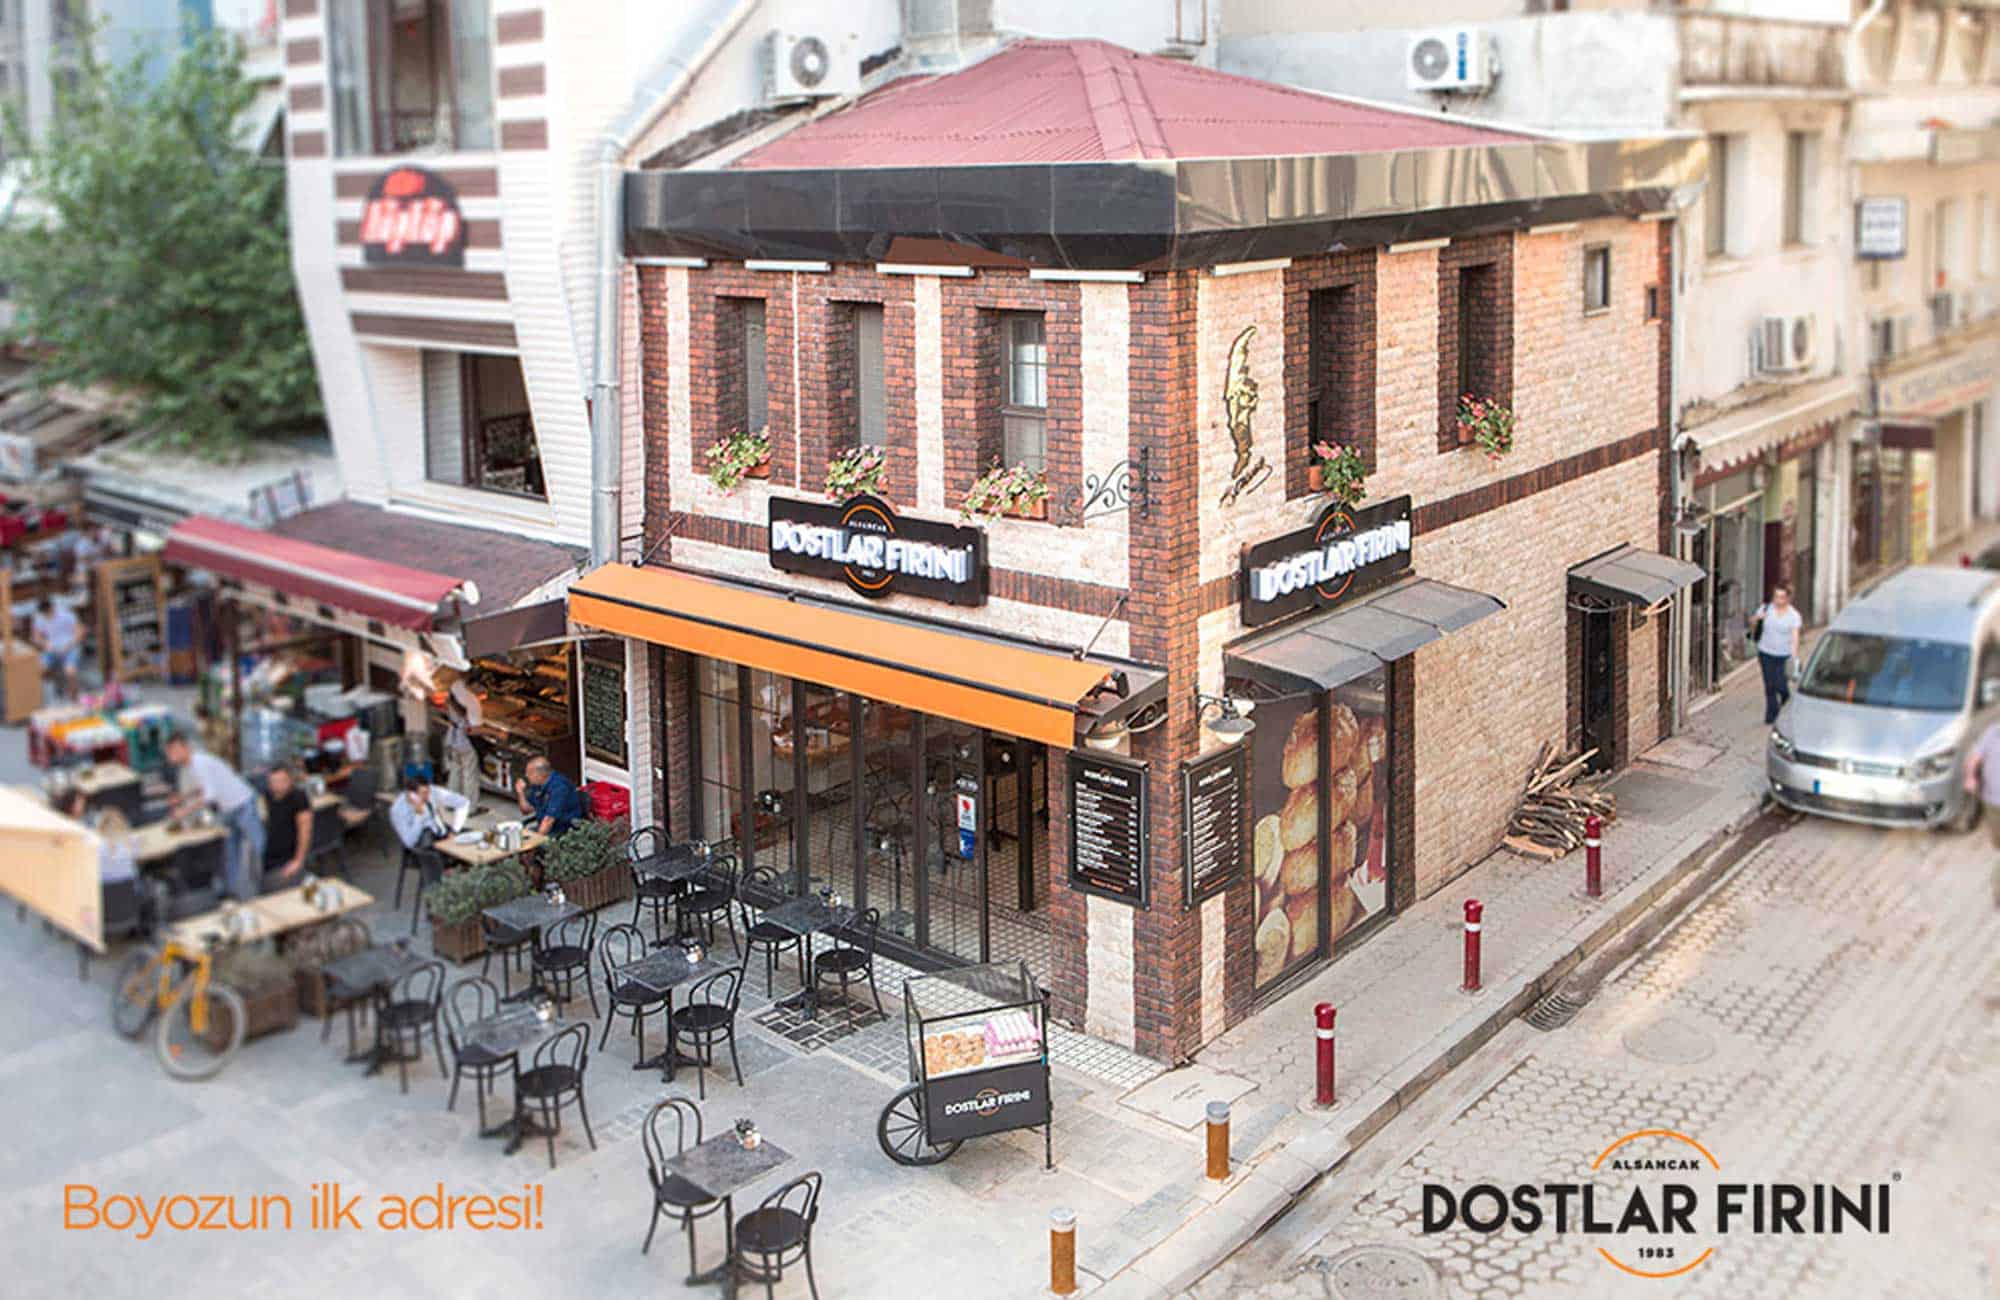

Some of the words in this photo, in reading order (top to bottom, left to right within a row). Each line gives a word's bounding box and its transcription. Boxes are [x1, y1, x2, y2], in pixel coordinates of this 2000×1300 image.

[771, 520, 884, 569] DOSTLAR
[886, 538, 968, 583] FIRINI
[1250, 540, 1357, 602] DOSTLAR
[945, 1096, 996, 1115] DOSTLAR
